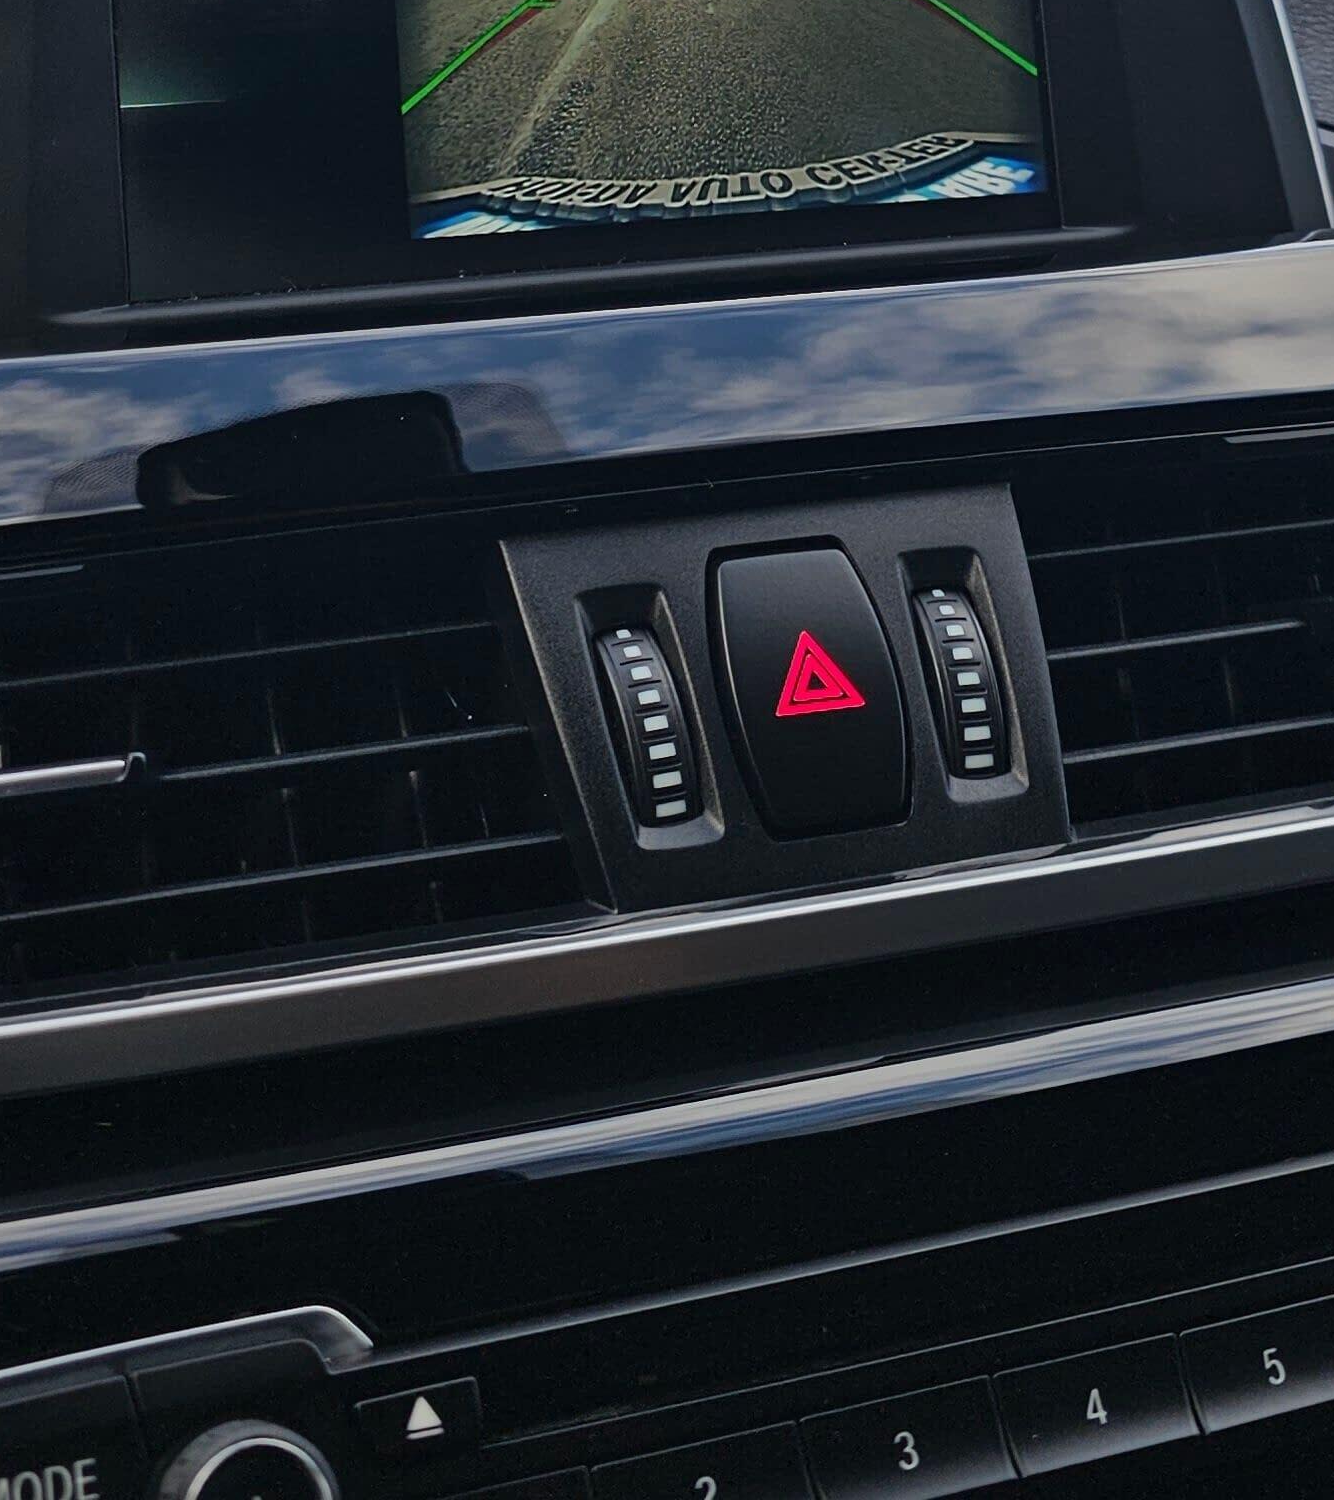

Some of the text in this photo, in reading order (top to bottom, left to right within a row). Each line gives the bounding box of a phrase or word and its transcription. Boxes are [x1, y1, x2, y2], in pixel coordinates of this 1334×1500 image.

[1262, 1347, 1288, 1386] 5
[1085, 1387, 1109, 1426] 4
[893, 1430, 921, 1471] 3
